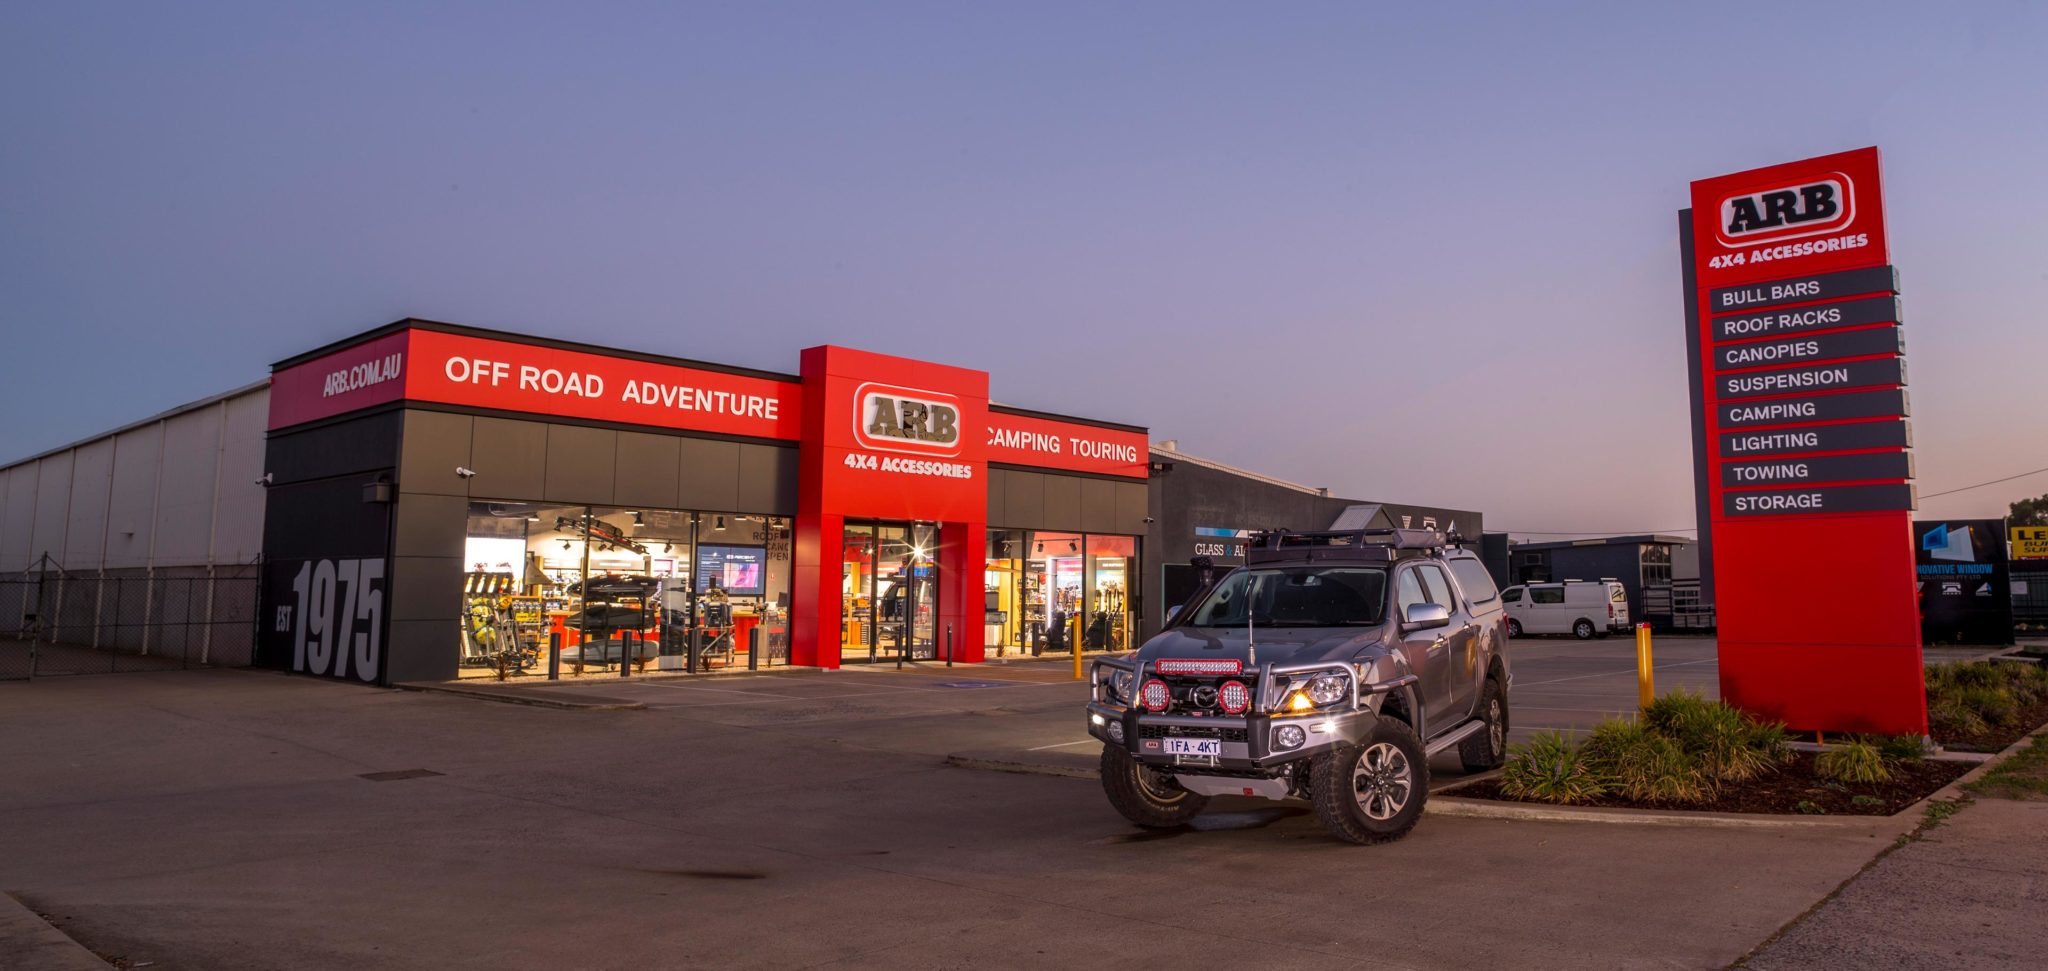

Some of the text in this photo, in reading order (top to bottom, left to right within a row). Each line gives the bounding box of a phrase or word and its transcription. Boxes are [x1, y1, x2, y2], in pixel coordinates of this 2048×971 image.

[1728, 183, 1838, 235] ARB
[1709, 233, 1869, 269] 4X4 ACCESSORIES
[1722, 281, 1820, 306] BULL BARS
[1724, 308, 1841, 335] ROOF RACKS
[1726, 341, 1819, 364] CANOPIES
[322, 352, 402, 398] ARB.COM.AU
[1728, 369, 1848, 393] SUSPENSION
[445, 356, 779, 420] OFF ROAD ADVENTURE
[869, 396, 958, 443] ARB
[1729, 402, 1816, 422] CAMPING
[1069, 438, 1137, 462] TOURING
[1732, 432, 1818, 451] LIGHTING
[843, 453, 972, 479] 4X4 ACCESSORIES
[1733, 464, 1808, 481] TOWING
[1735, 494, 1822, 511] STORAGE
[1195, 543, 1246, 557] GLASS & AL
[1957, 563, 1993, 575] WINDOW
[275, 605, 292, 632] EST
[292, 558, 385, 682] 1975
